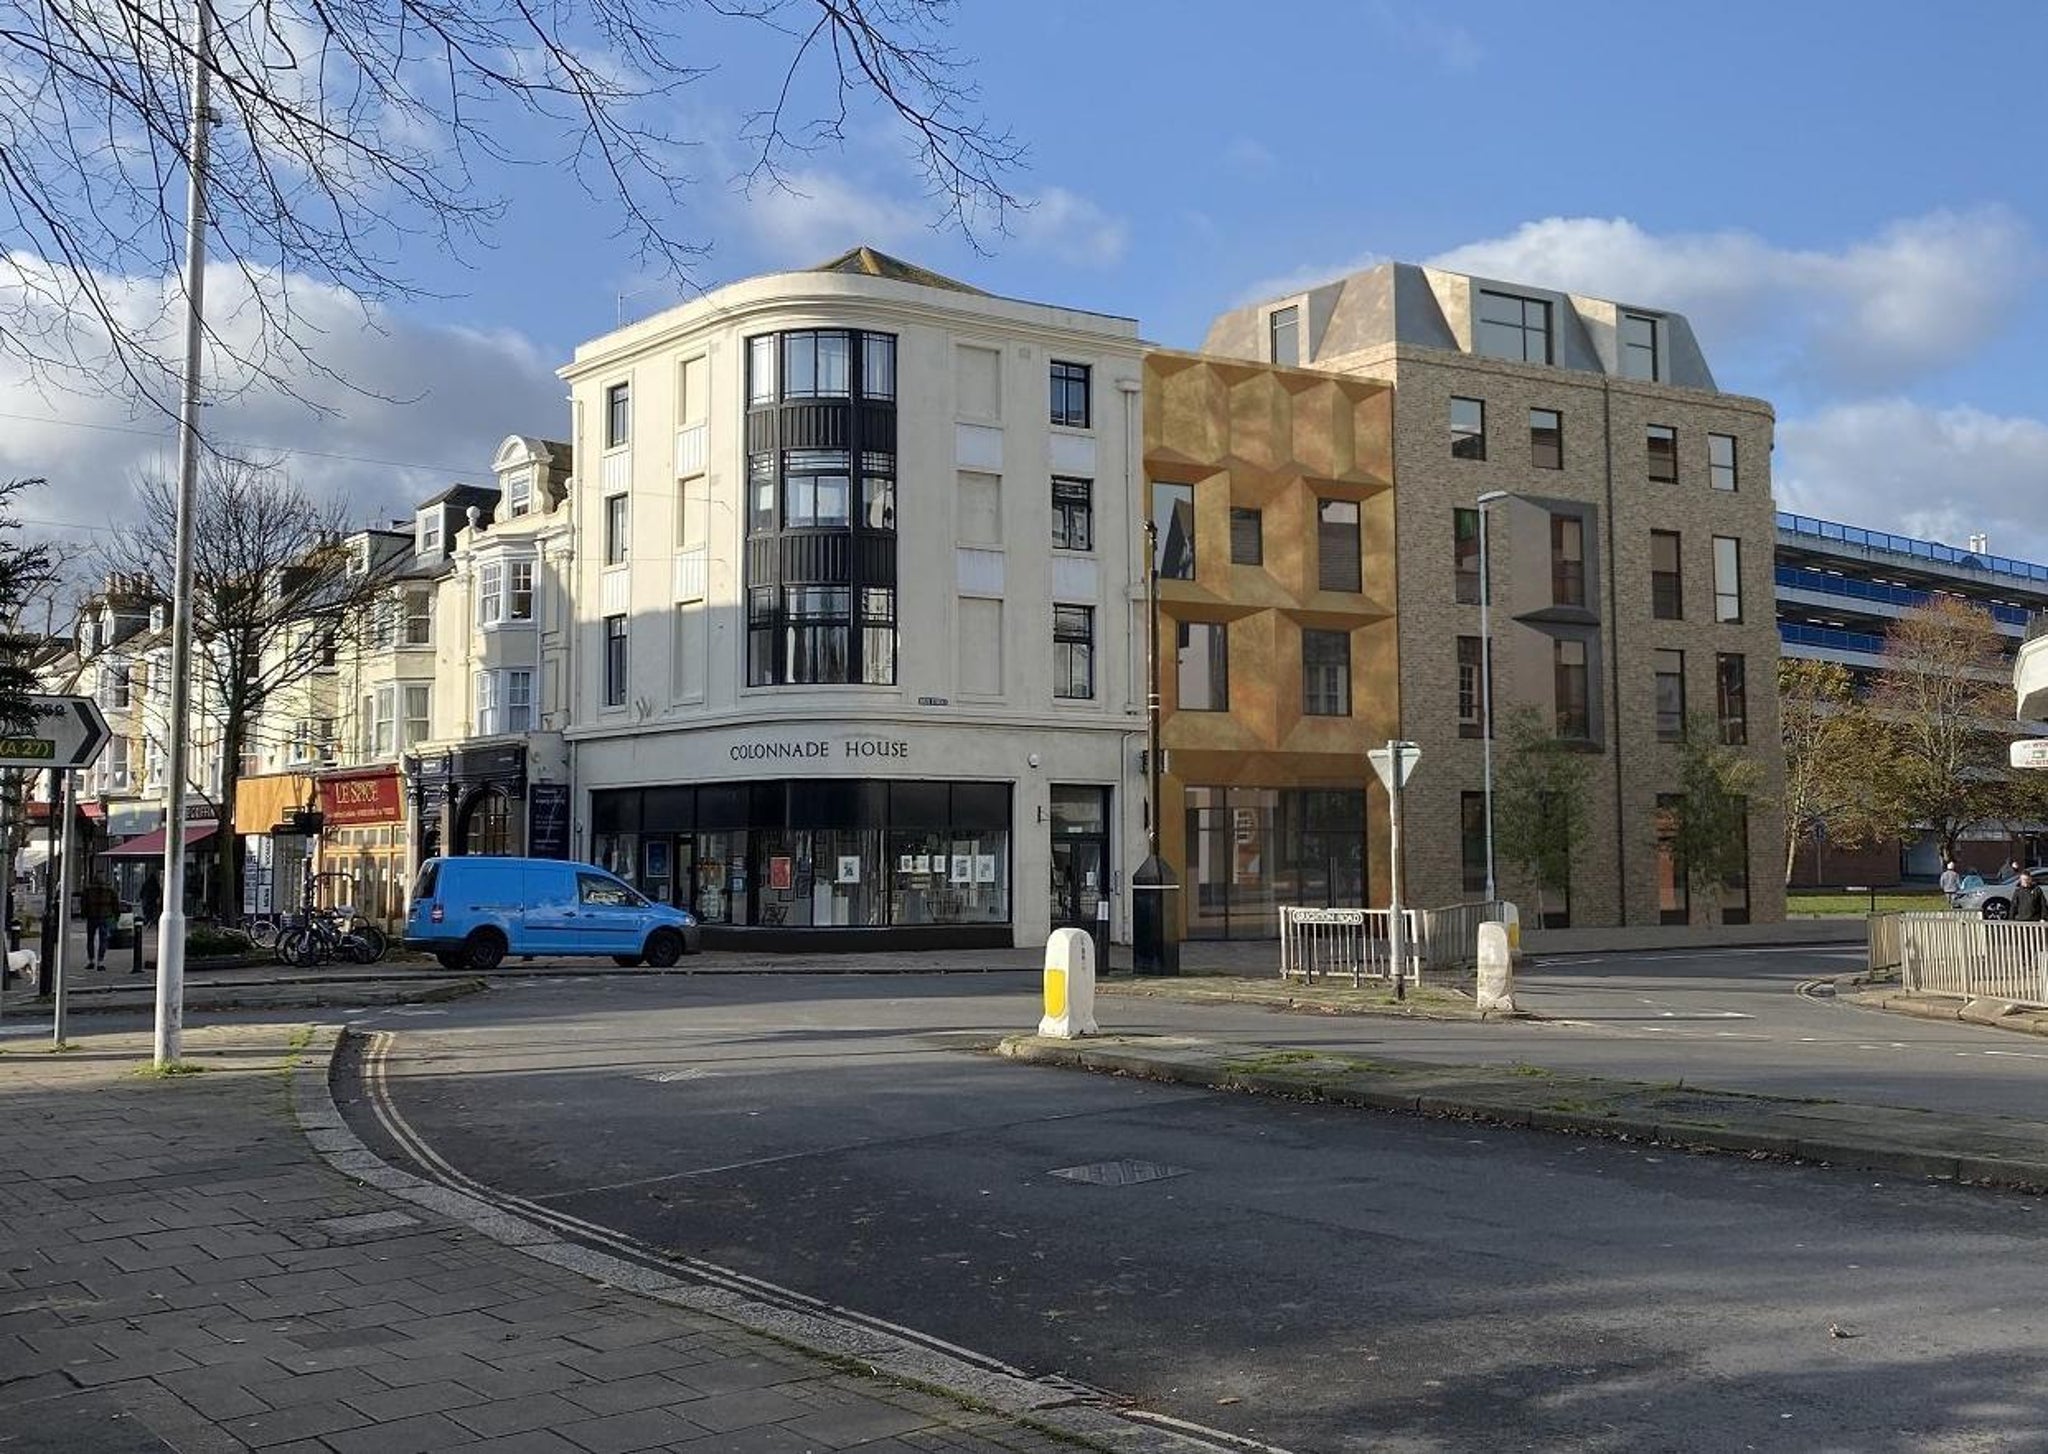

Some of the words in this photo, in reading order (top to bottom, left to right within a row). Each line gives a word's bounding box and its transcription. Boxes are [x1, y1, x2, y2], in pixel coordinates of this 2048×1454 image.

[0, 741, 17, 756] (A
[22, 741, 49, 757] 27)
[730, 741, 829, 760] COLONNADE
[845, 741, 908, 758] HOUSE
